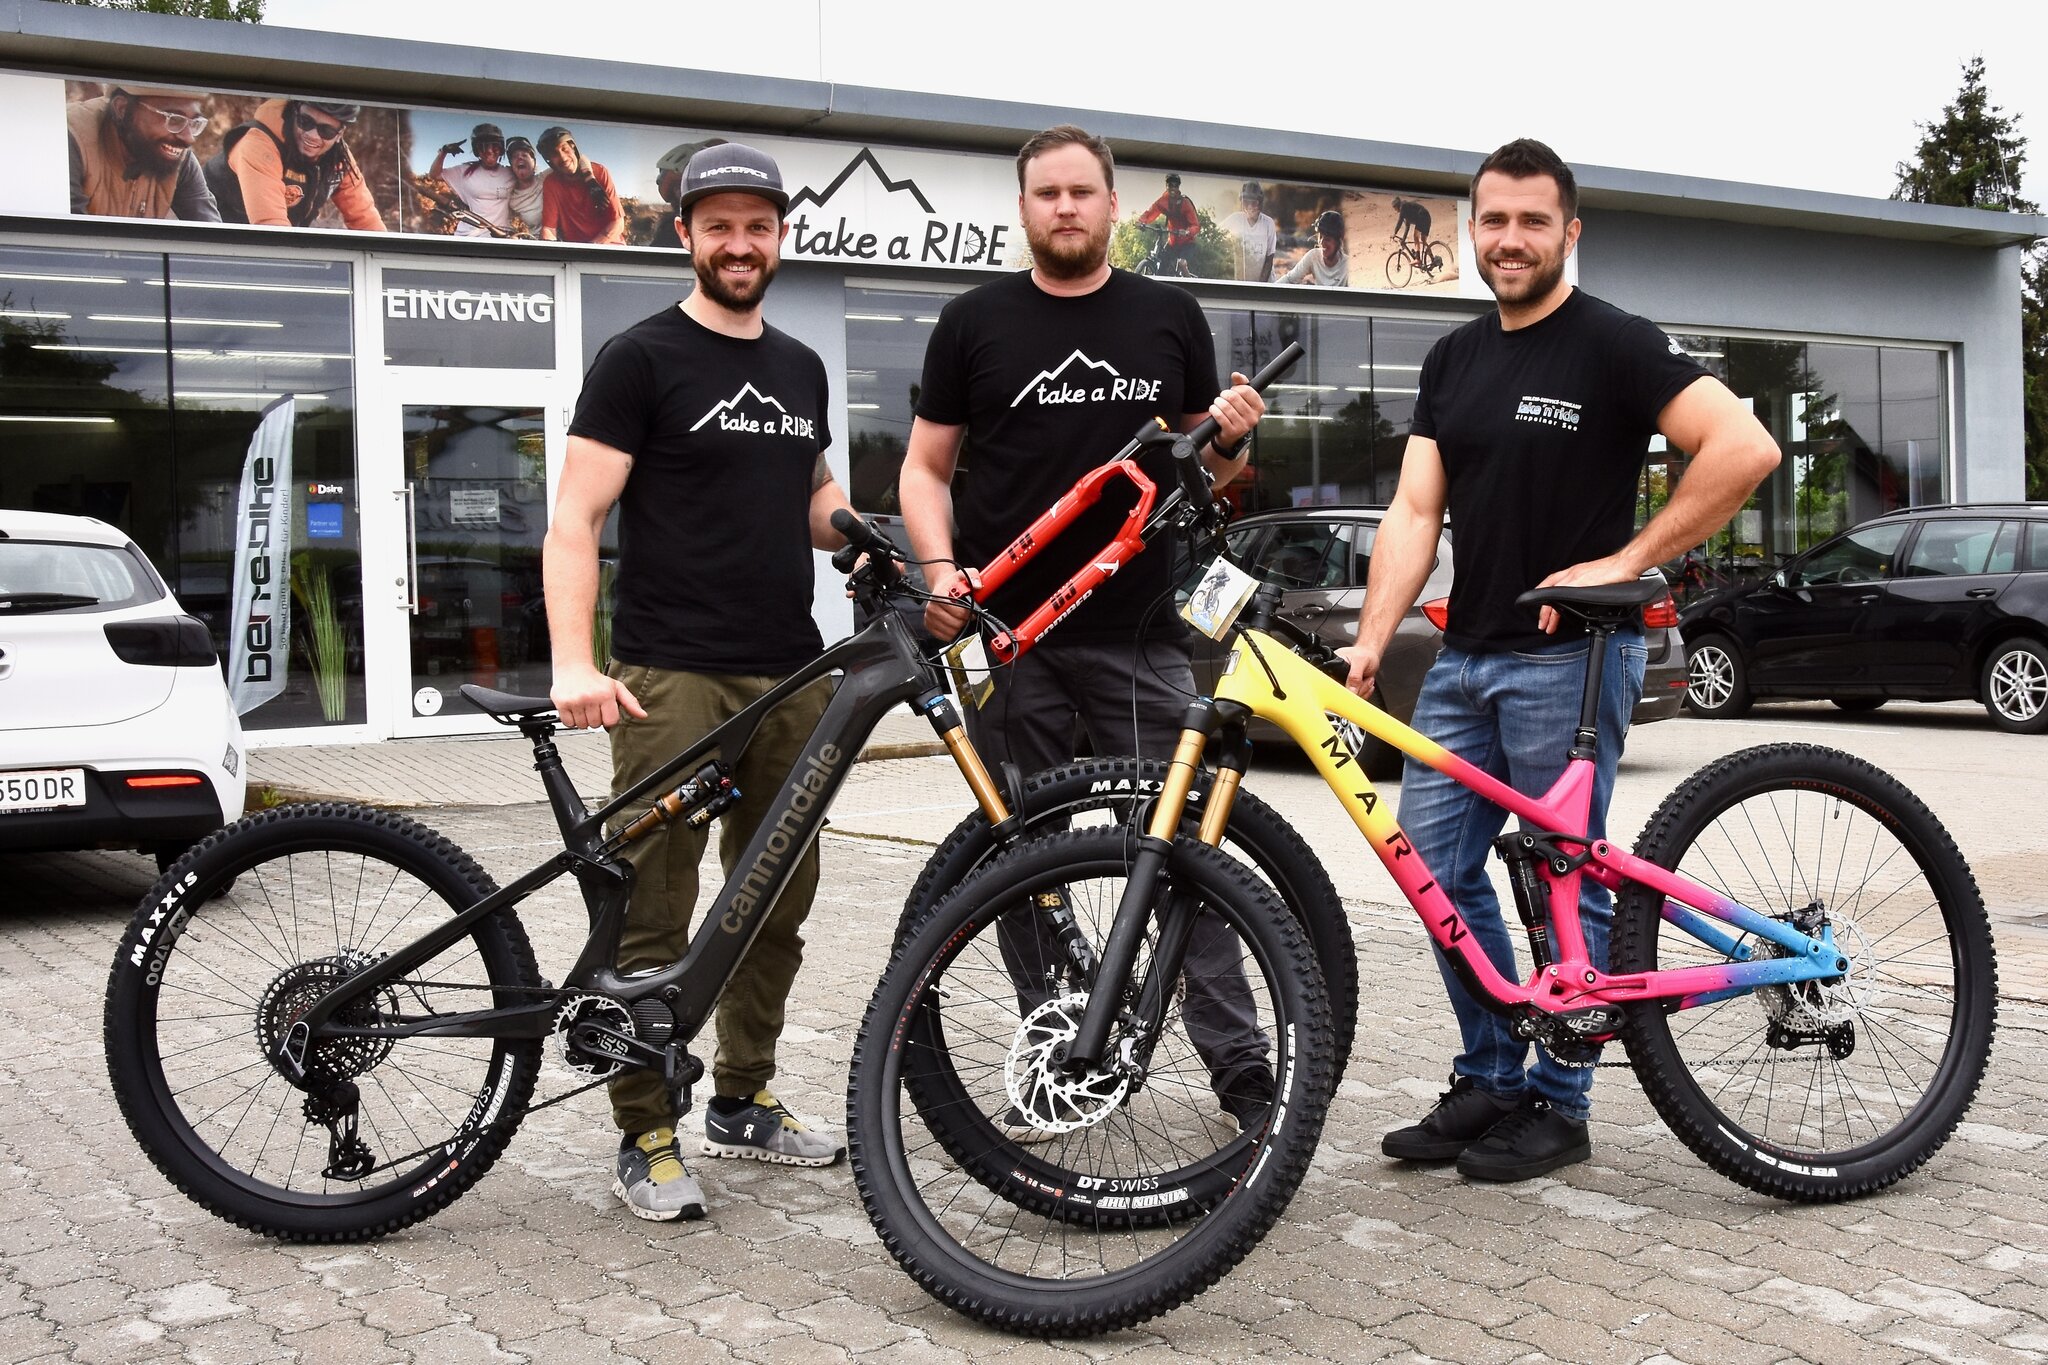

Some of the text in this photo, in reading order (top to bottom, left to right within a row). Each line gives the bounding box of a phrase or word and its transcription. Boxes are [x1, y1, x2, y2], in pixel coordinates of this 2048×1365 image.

[793, 214, 1009, 266] take a RIDE
[386, 288, 551, 323] EINGANG
[1036, 378, 1162, 405] take a RIDE
[718, 411, 815, 440] take a RIDE
[1090, 778, 1202, 802] MAXXS
[720, 743, 842, 935] cannondale
[1321, 734, 1467, 944] MARIN
[130, 871, 198, 968] MAXXIS
[925, 922, 975, 978] ALIFORNIA
[1287, 1022, 1296, 1058] VEE
[1281, 1059, 1295, 1105] TIRE
[465, 1083, 493, 1131] SWISS
[1077, 1175, 1159, 1193] DT SWISS
